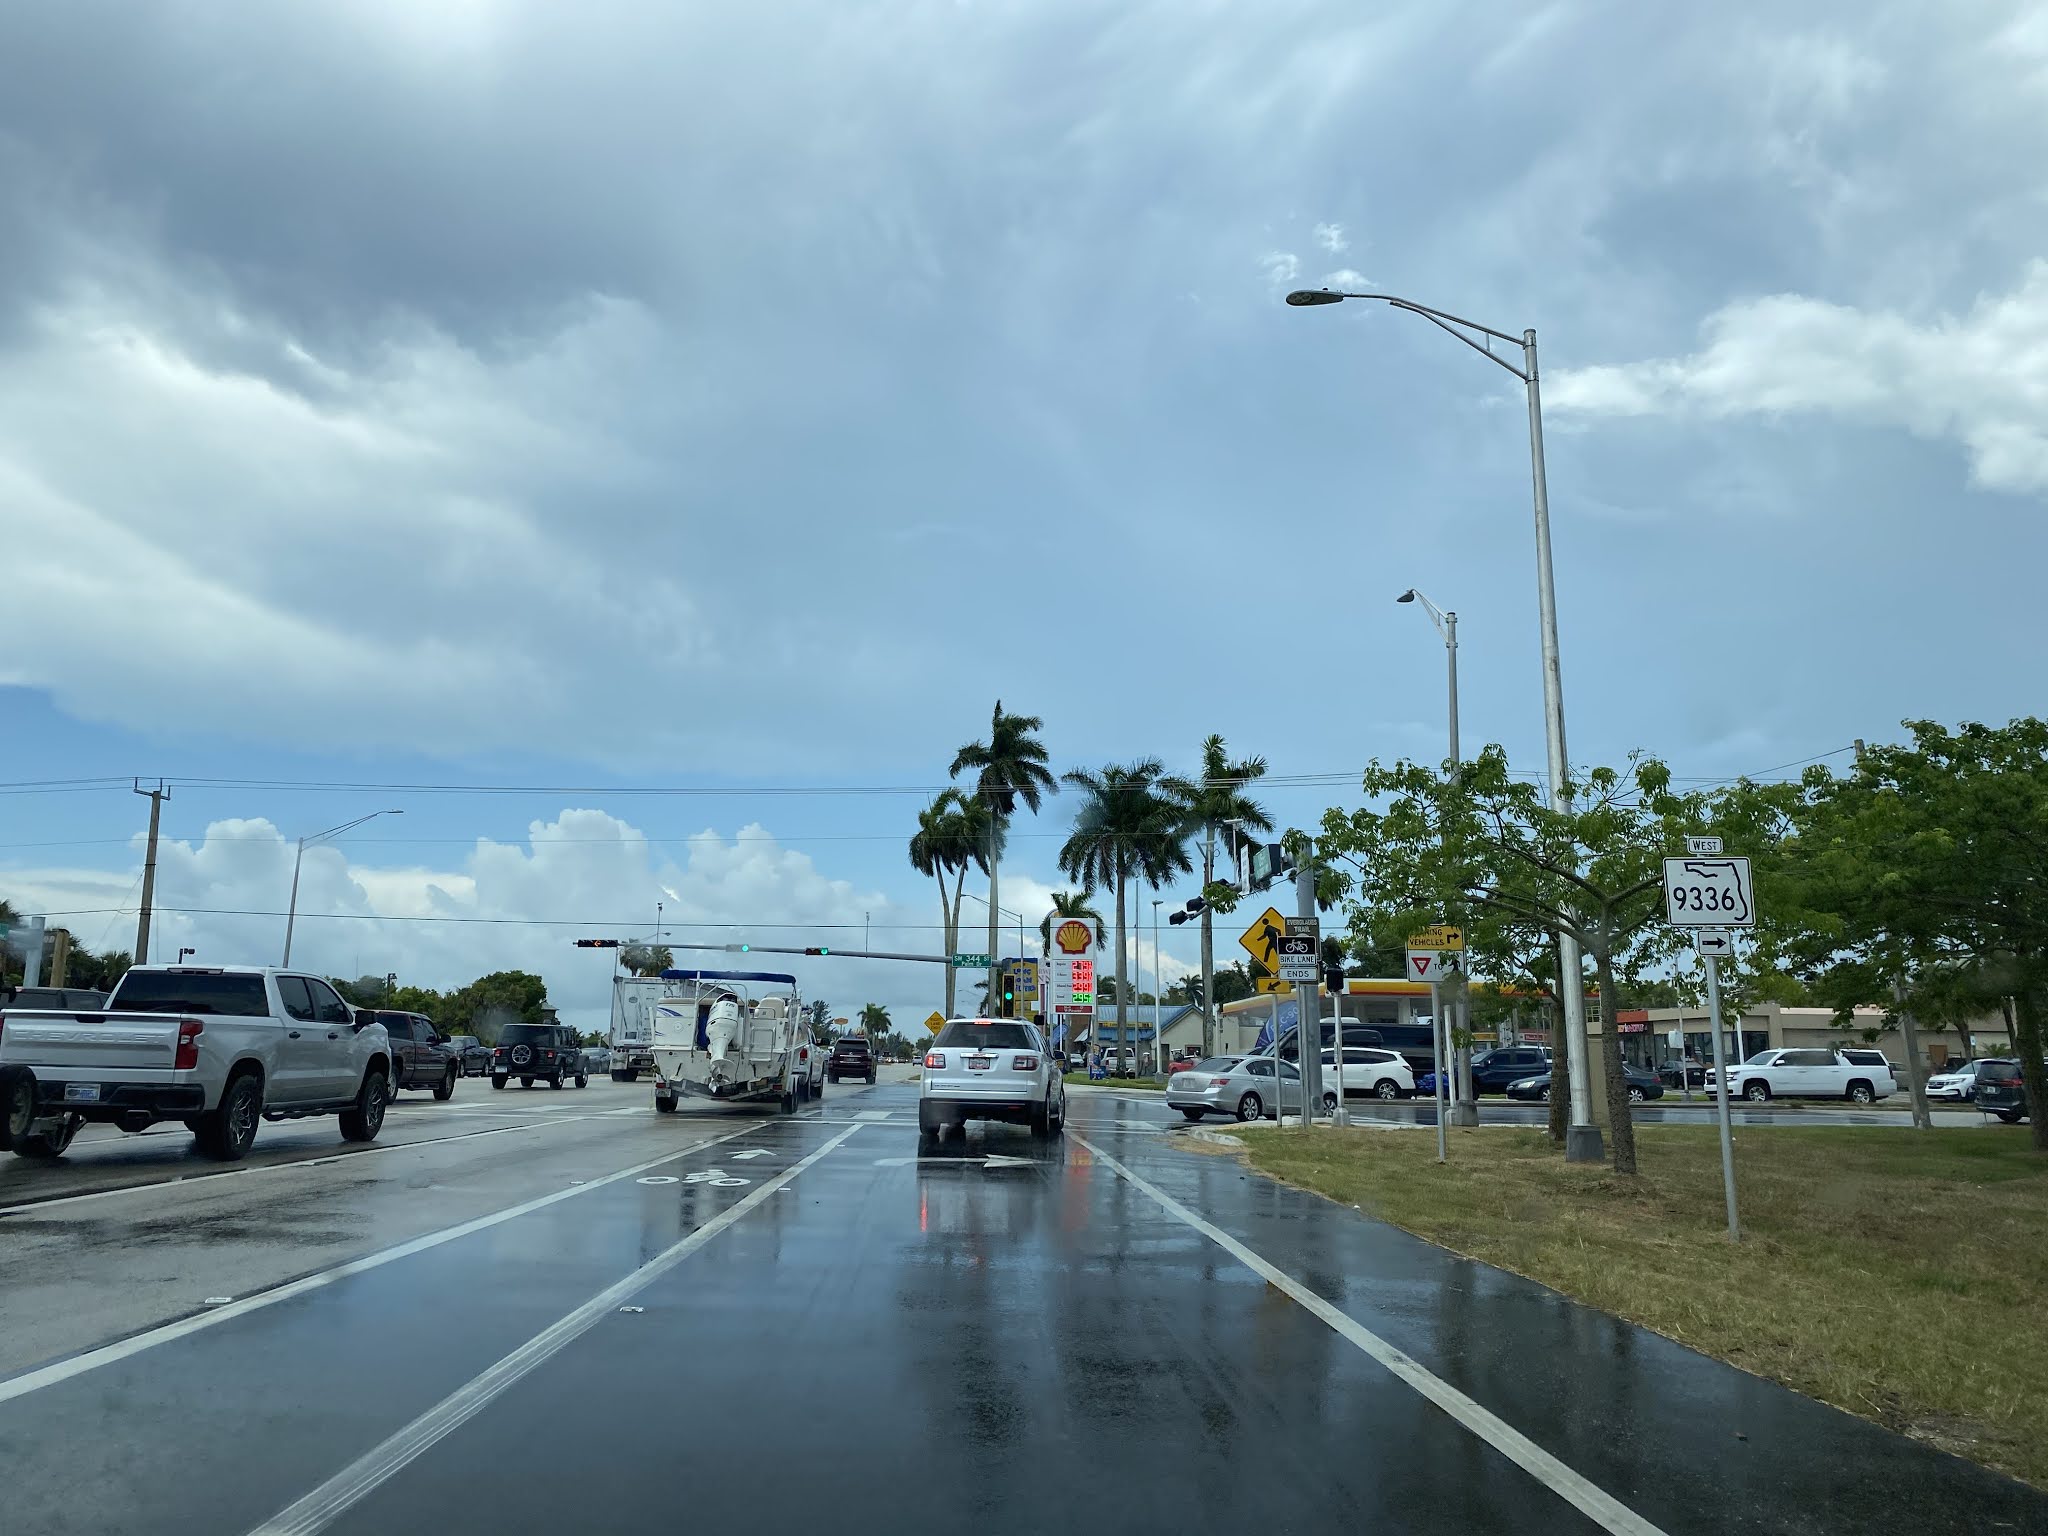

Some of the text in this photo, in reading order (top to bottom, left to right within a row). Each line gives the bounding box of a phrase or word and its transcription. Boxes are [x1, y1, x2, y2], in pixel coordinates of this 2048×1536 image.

[1693, 840, 1717, 850] WEST
[1673, 887, 1735, 911] 9336
[13, 1031, 167, 1044] CHEVROLET
